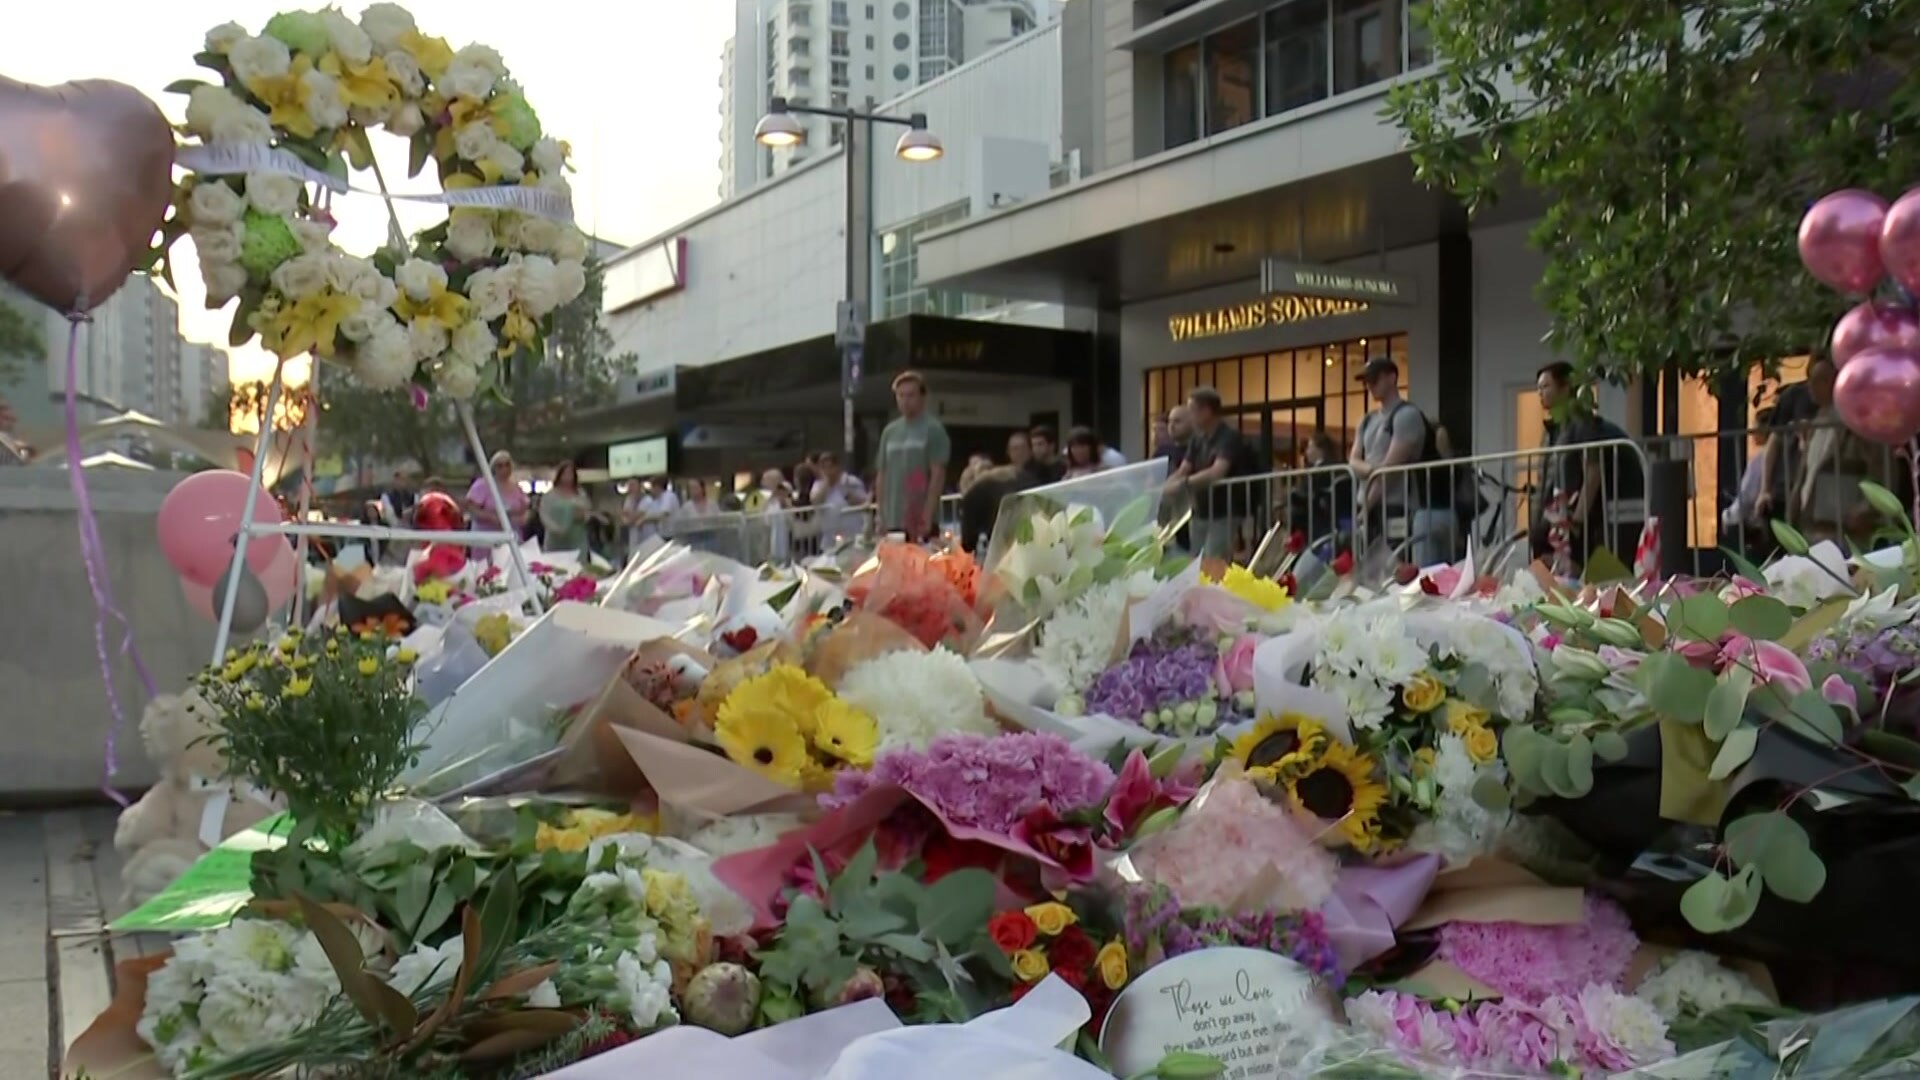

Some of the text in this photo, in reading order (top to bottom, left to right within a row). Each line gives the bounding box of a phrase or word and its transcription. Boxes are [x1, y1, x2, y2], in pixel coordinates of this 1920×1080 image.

[1159, 977, 1212, 1022] Those
[1219, 995, 1236, 1007] we
[1193, 1016, 1217, 1031] don't
[1218, 1016, 1231, 1029] go
[1207, 1031, 1238, 1046] beside
[1239, 1031, 1252, 1041] us
[1238, 1045, 1255, 1058] but
